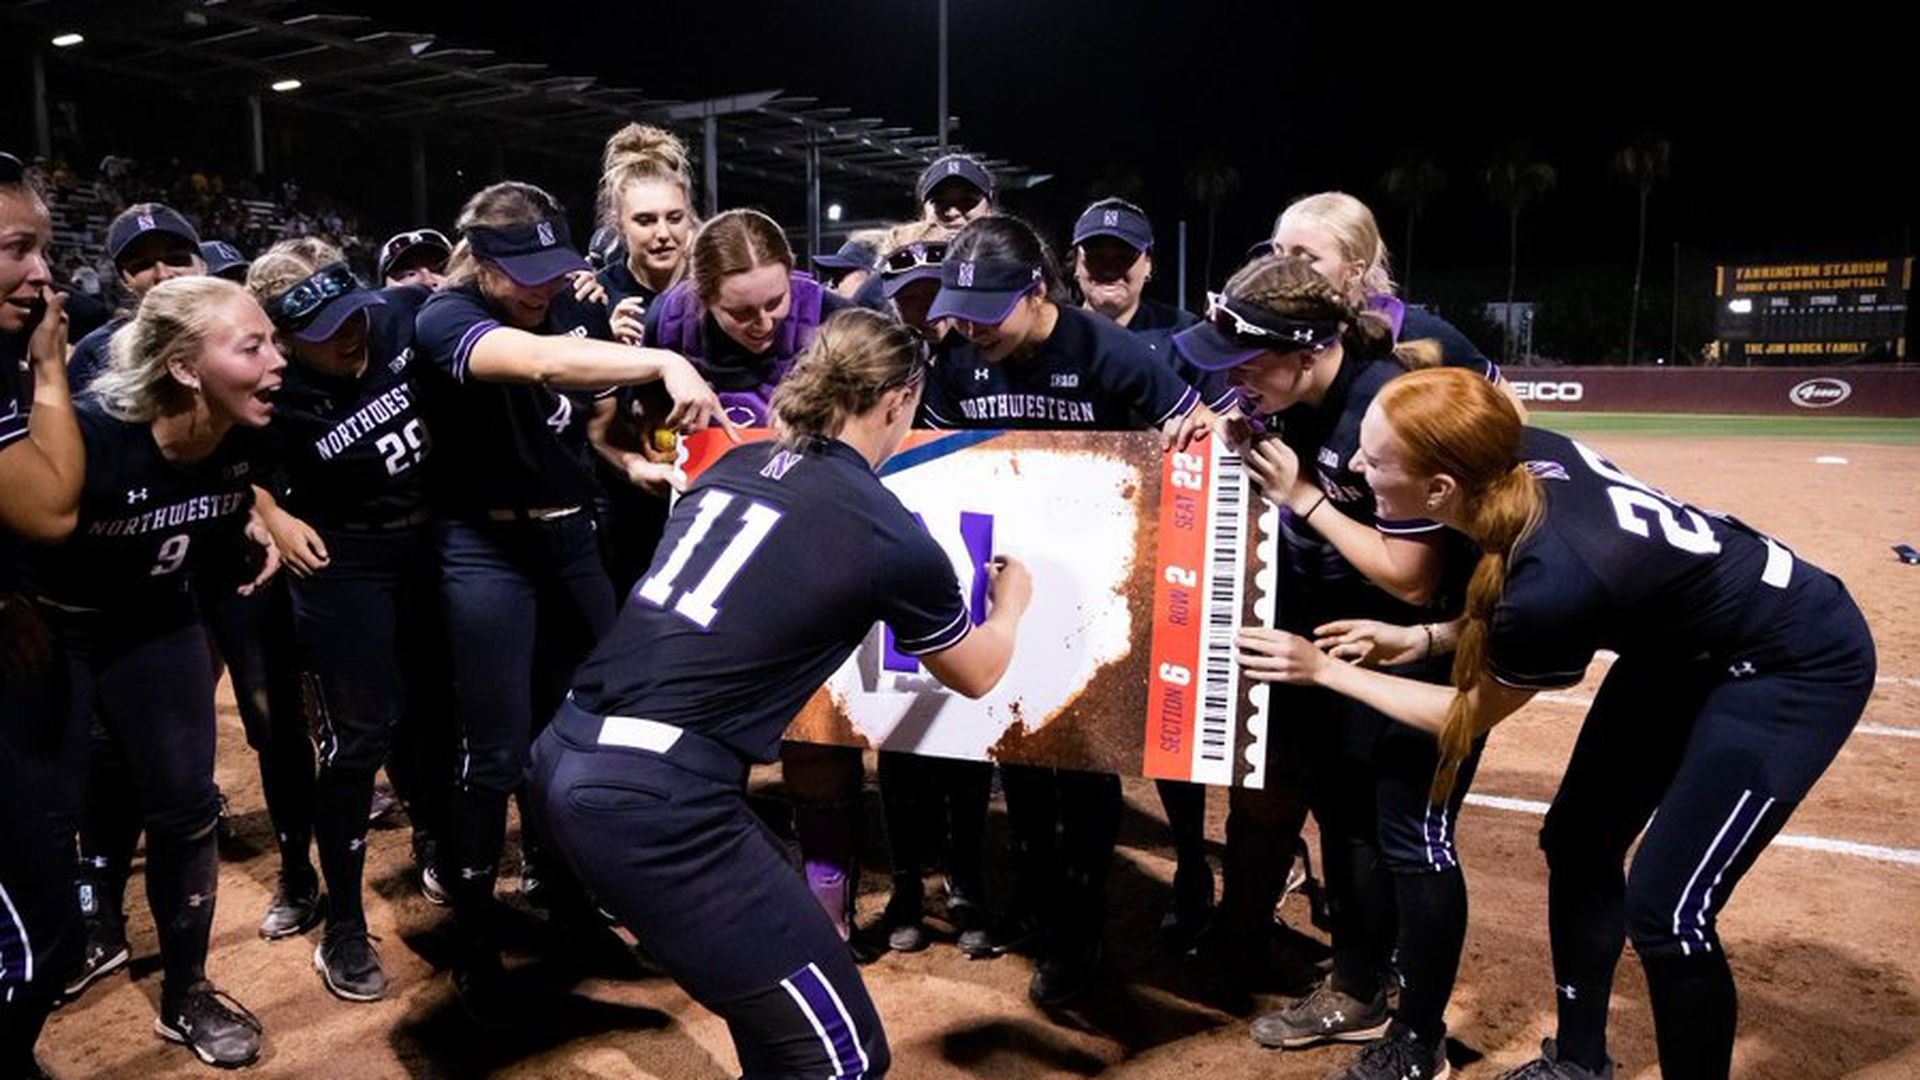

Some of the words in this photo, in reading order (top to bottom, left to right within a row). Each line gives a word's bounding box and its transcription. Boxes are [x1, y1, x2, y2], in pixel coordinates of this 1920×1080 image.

[1823, 261, 1888, 276] STADIUM
[959, 394, 1096, 423] NORTHWESTERN
[1509, 381, 1584, 401] EICO
[315, 382, 411, 461] NORTHWEST
[759, 449, 803, 481] N
[1171, 452, 1204, 492] 22
[1174, 494, 1196, 531] SEAT
[150, 534, 190, 576] 9
[636, 487, 784, 630] 11
[1164, 564, 1197, 588] 2
[1168, 588, 1189, 626] ROW
[1159, 661, 1192, 687] 6
[1160, 687, 1183, 754] SECTION
